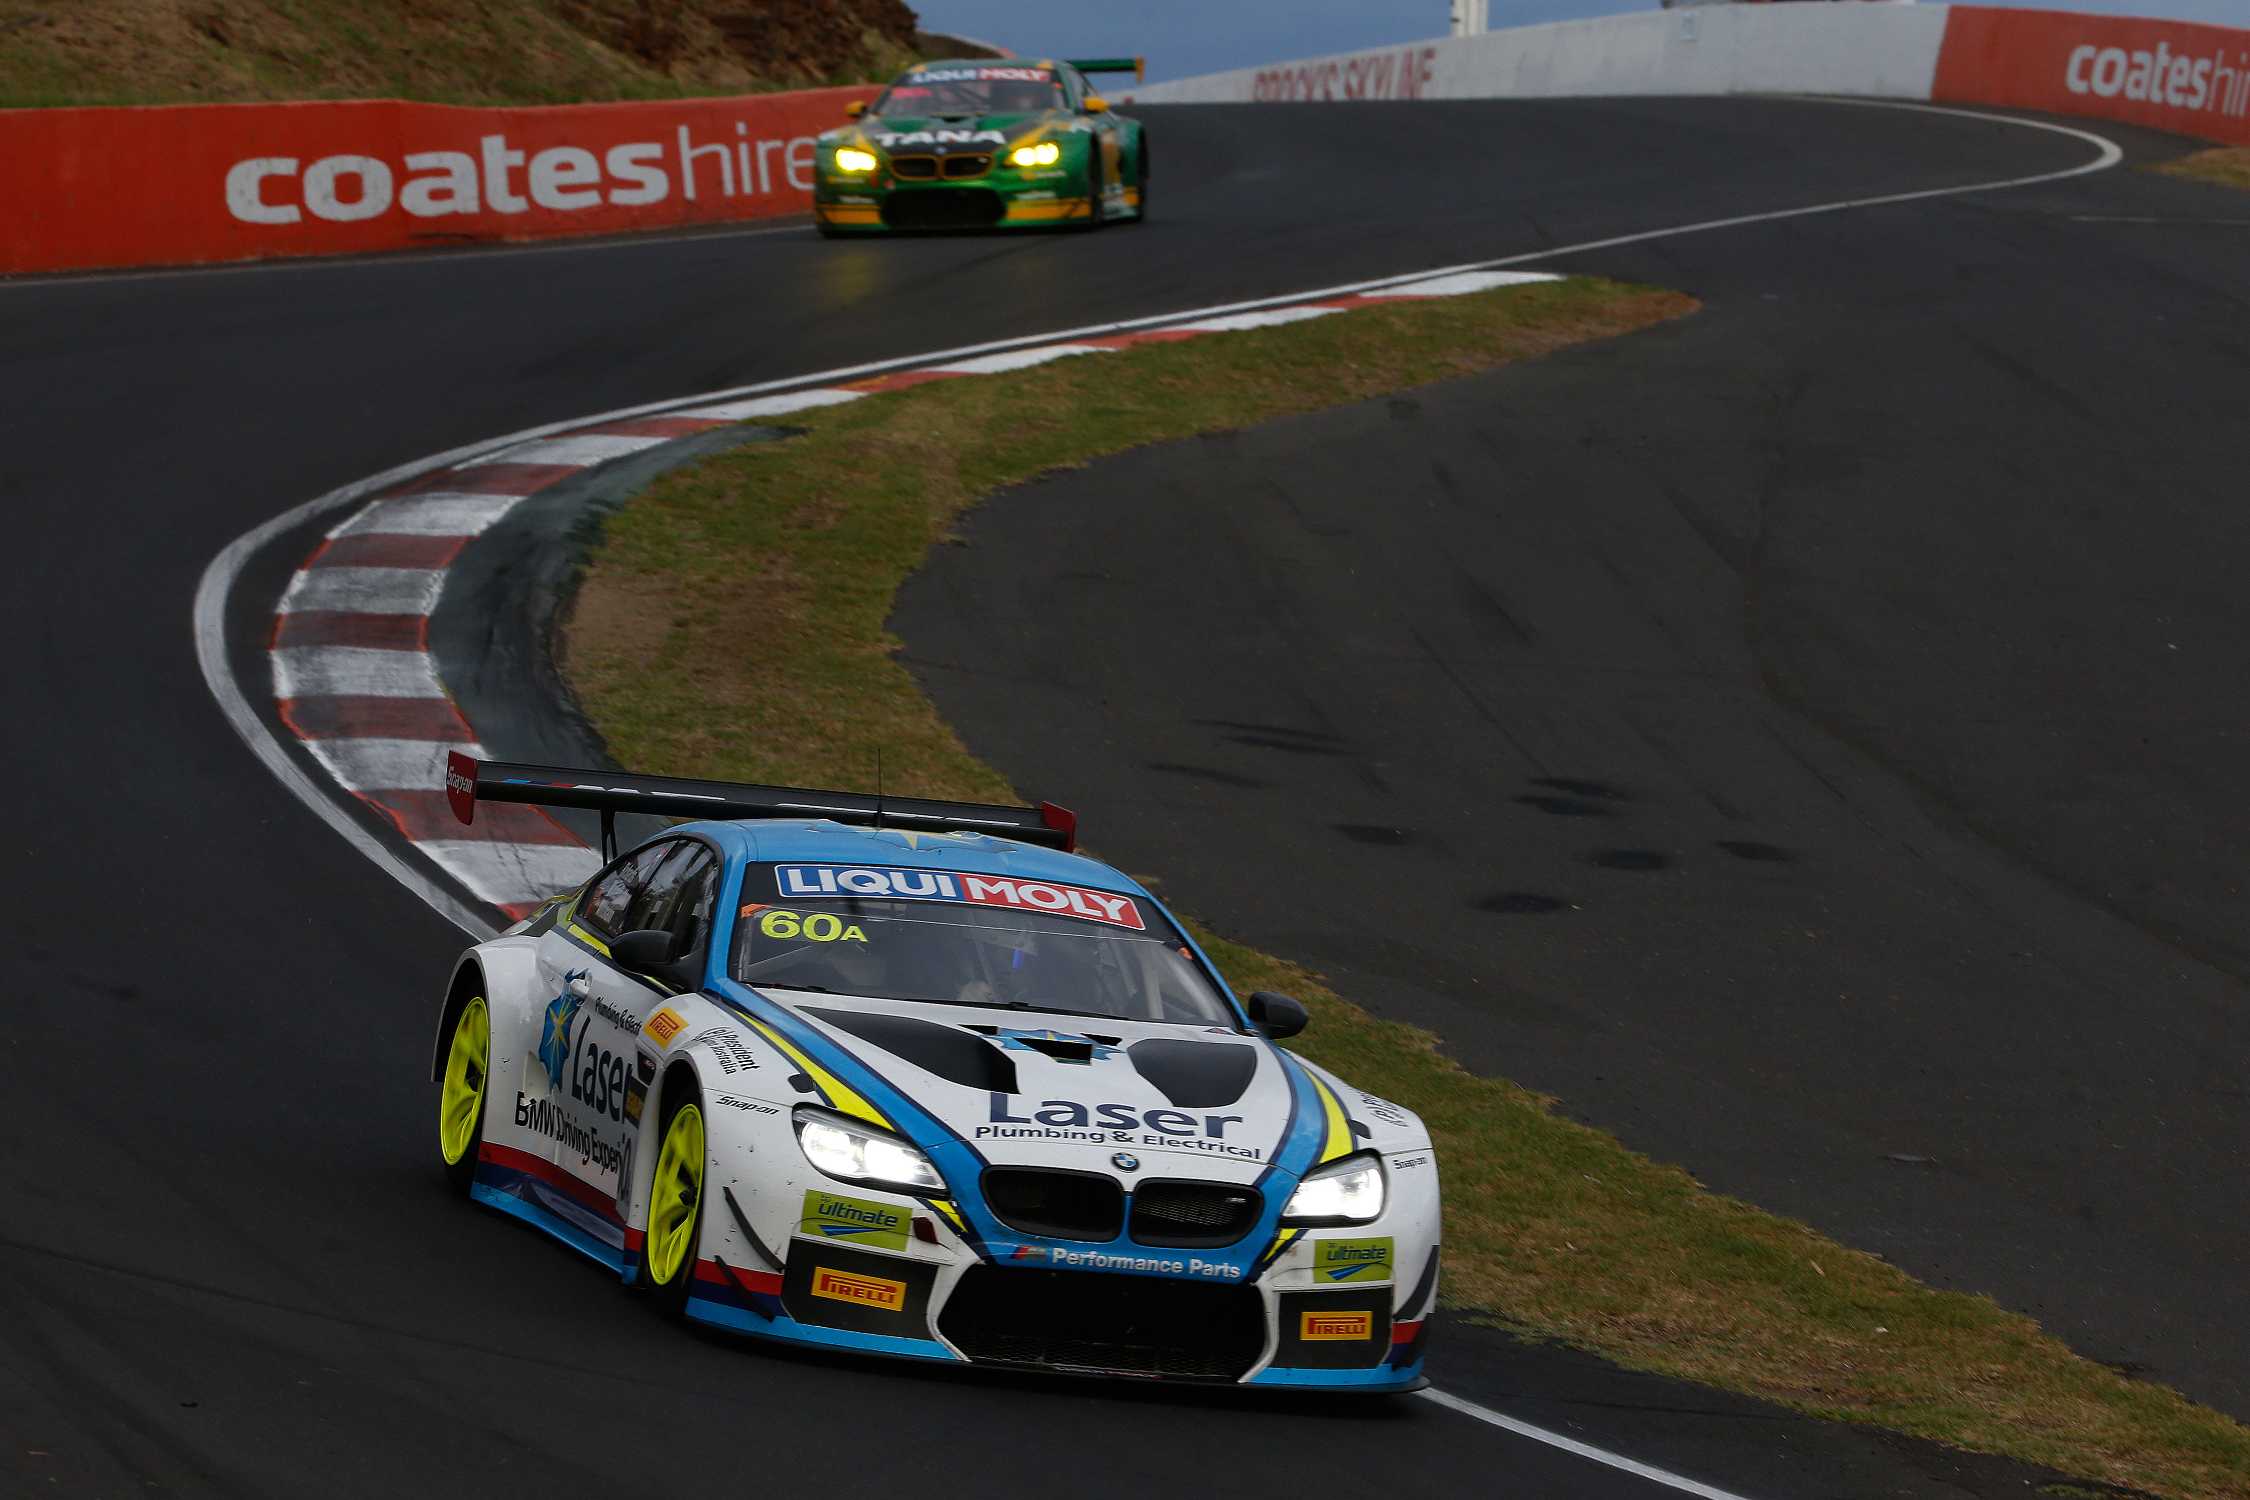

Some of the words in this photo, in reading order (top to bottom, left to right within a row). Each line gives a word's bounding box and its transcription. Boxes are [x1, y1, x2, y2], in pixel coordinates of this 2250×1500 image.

[786, 869, 958, 898] LIQUI
[964, 877, 1130, 923] MOLY
[571, 1015, 633, 1125] Laser
[715, 1095, 781, 1116] Snap-on
[989, 1091, 1244, 1140] Laser
[975, 1126, 1106, 1144] Plumbing
[1114, 1130, 1135, 1143] &
[1143, 1134, 1262, 1160] Electrical
[818, 1201, 899, 1228] ultimate
[1051, 1247, 1184, 1274] Performance
[1188, 1258, 1242, 1279] Parts
[820, 1273, 898, 1304] PIRELLI
[1307, 1316, 1367, 1335] PIRELLI
